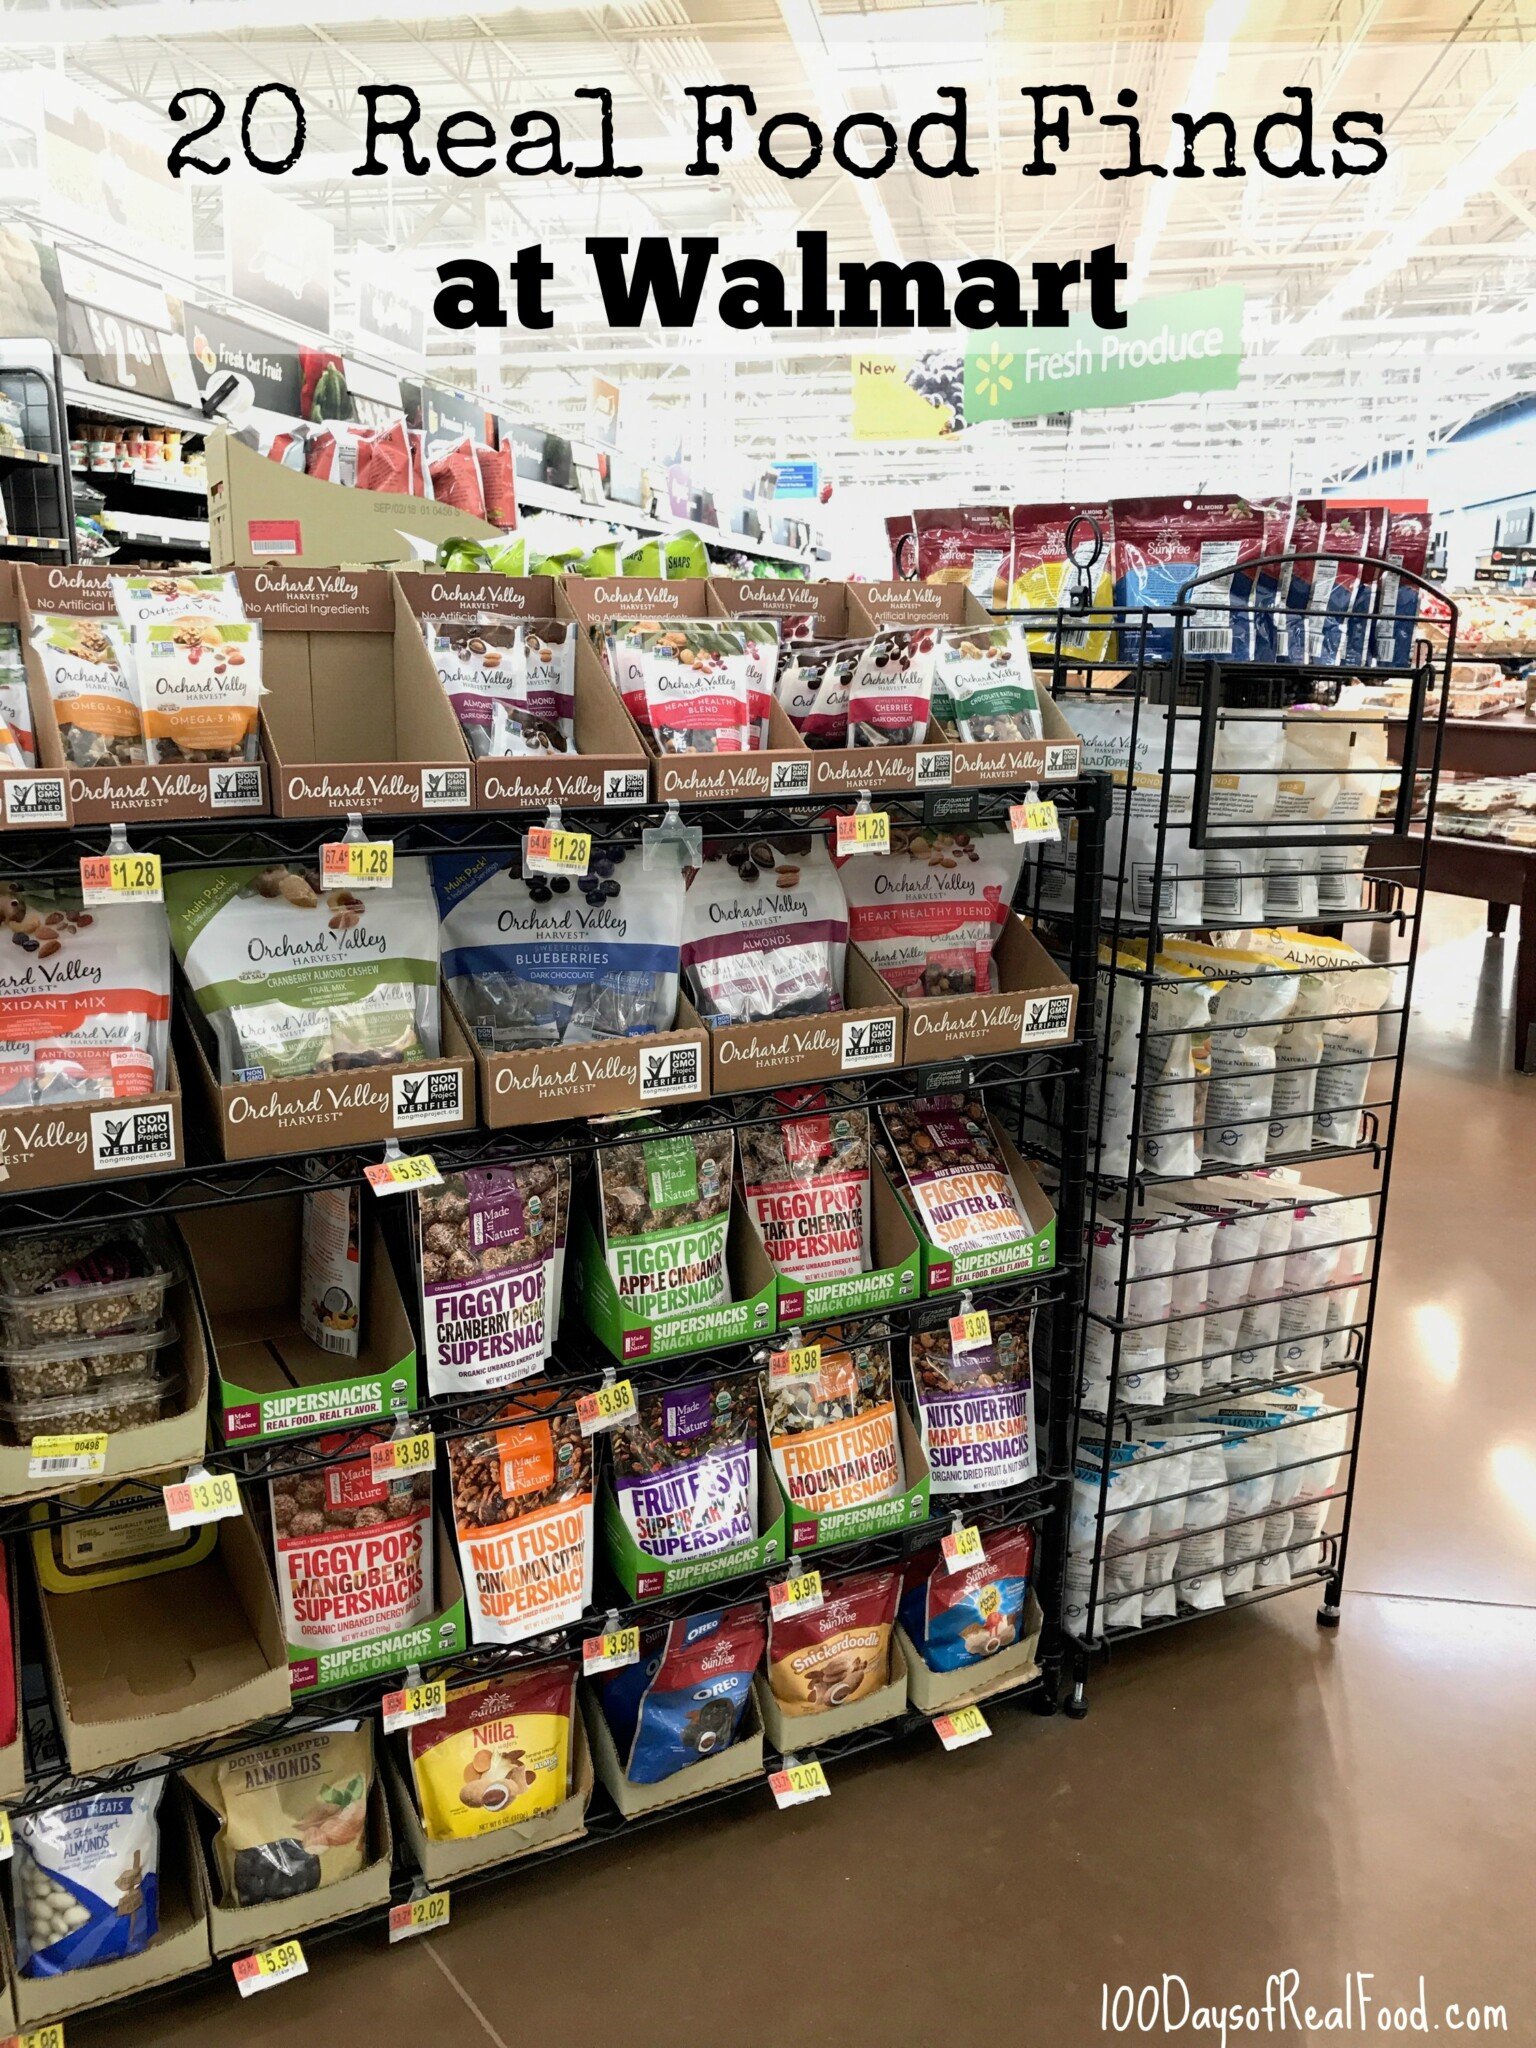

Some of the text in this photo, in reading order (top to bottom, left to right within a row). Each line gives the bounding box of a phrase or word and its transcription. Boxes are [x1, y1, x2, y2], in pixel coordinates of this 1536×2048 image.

[219, 343, 283, 382] Fresh Cut Fruit
[859, 361, 896, 376] New
[1025, 327, 1224, 384] Fresh Produce
[668, 555, 691, 569] SNAPS
[245, 604, 370, 615] No Artificial Ingredients
[874, 611, 949, 622] Artificial Ingredients
[71, 702, 121, 714] OMEGA-3
[170, 714, 224, 725] OMEGA-3
[688, 706, 718, 714] BLEND
[875, 703, 913, 712] CHERRIES
[818, 758, 914, 785] Orchard Valley
[955, 752, 1043, 776] Orchard Valley
[70, 775, 208, 802] Orchard Valley
[289, 772, 419, 801] Orchard Valley
[485, 777, 601, 802] Orchard Valley
[664, 768, 769, 792] Orchard Valley
[352, 849, 388, 874] $1.28
[444, 856, 487, 893] Multi Pack!
[182, 875, 228, 920] Multi Pack!
[498, 909, 627, 937] Orchard Valley
[710, 899, 807, 925] Orchard Valley
[859, 906, 991, 923] HEART HEALTHY BLEND
[248, 932, 387, 963] Orchard Valley
[742, 934, 792, 949] ALMONDS
[516, 954, 609, 965] BLUEBERRIES
[268, 965, 379, 988] CRANBERRY ALMOND CASHEW
[551, 971, 594, 979] CHOCOLATE
[308, 983, 347, 995] TRAIL MIX
[70, 997, 106, 1010] MIX
[914, 1006, 1022, 1038] Orchard Valley
[719, 1030, 840, 1063] Orchard Valley
[430, 1074, 456, 1085] NON
[430, 1082, 457, 1092] GMO
[496, 1058, 637, 1094] Orchard Valley
[643, 1075, 696, 1087] VERIFIED
[229, 1084, 390, 1124] Orchard Valley
[398, 1100, 457, 1112] VERIFIED
[138, 1113, 167, 1125] NON
[138, 1123, 168, 1133] GMO
[14, 1122, 88, 1156] Valley
[103, 1142, 169, 1155] VERIFIED
[138, 1132, 168, 1142] Project
[99, 1151, 172, 1164] nongmoproject.org
[935, 1164, 995, 1177] NUT BUTTER FILLED
[663, 1169, 687, 1179] Made
[665, 1188, 696, 1201] Nature
[757, 1195, 820, 1222] FIGGY
[822, 1183, 861, 1212] POPS
[483, 1206, 509, 1220] Made
[485, 1225, 519, 1244] Nature
[761, 1213, 850, 1240] TART CHERRY
[617, 1242, 682, 1275] FIGGY
[685, 1227, 723, 1258] POPS
[954, 1243, 1033, 1274] SUPERSNACKS
[619, 1252, 722, 1295] APPLE CINNAMON
[955, 1261, 1031, 1283] REAL FOOD. REAL FLAVOR.
[806, 1273, 895, 1303] SUPERSNACKS
[806, 1289, 893, 1316] SNACK ON THAT.
[654, 1306, 748, 1341] SUPERSNACKS
[653, 1322, 747, 1354] SNACK ON THAT.
[263, 1382, 382, 1418] SUPERSNACKS
[599, 1386, 630, 1412] $3.98
[677, 1401, 700, 1415] Made
[927, 1393, 1026, 1429] NUTS OVER FRUIT
[266, 1403, 379, 1431] REAL FOOD. REAL FLAVOR.
[74, 1439, 100, 1451] 00498
[928, 1417, 1028, 1447] MAPLE BALSAMIC
[783, 1436, 840, 1477] FRUIT
[843, 1416, 894, 1457] FUSION
[787, 1456, 870, 1499] MOUNTAIN
[871, 1445, 897, 1472] GOLD
[343, 1486, 381, 1502] Nature
[632, 1476, 687, 1517] FRUIT
[288, 1524, 423, 1579] FIGGY POPS
[292, 1551, 420, 1599] MANGOBERRY
[476, 1556, 550, 1594] CINNAMON
[294, 1570, 423, 1621] SUPERSNACKS
[687, 1618, 718, 1642] OREO
[321, 1627, 431, 1670] SUPERSNACKS
[791, 1631, 879, 1676] Snickerdoodle
[321, 1644, 431, 1684] SNACK ON THAT.
[692, 1675, 739, 1701] OREO
[472, 1722, 515, 1748] Nilla
[229, 1735, 330, 1772] DOUBLE DIPPED
[245, 1753, 322, 1788] ALMONDS
[85, 1802, 124, 1814] TREATS
[95, 1819, 120, 1835] Yogurt
[64, 1834, 109, 1859] ALMONDS
[413, 1899, 444, 1923] $2.02
